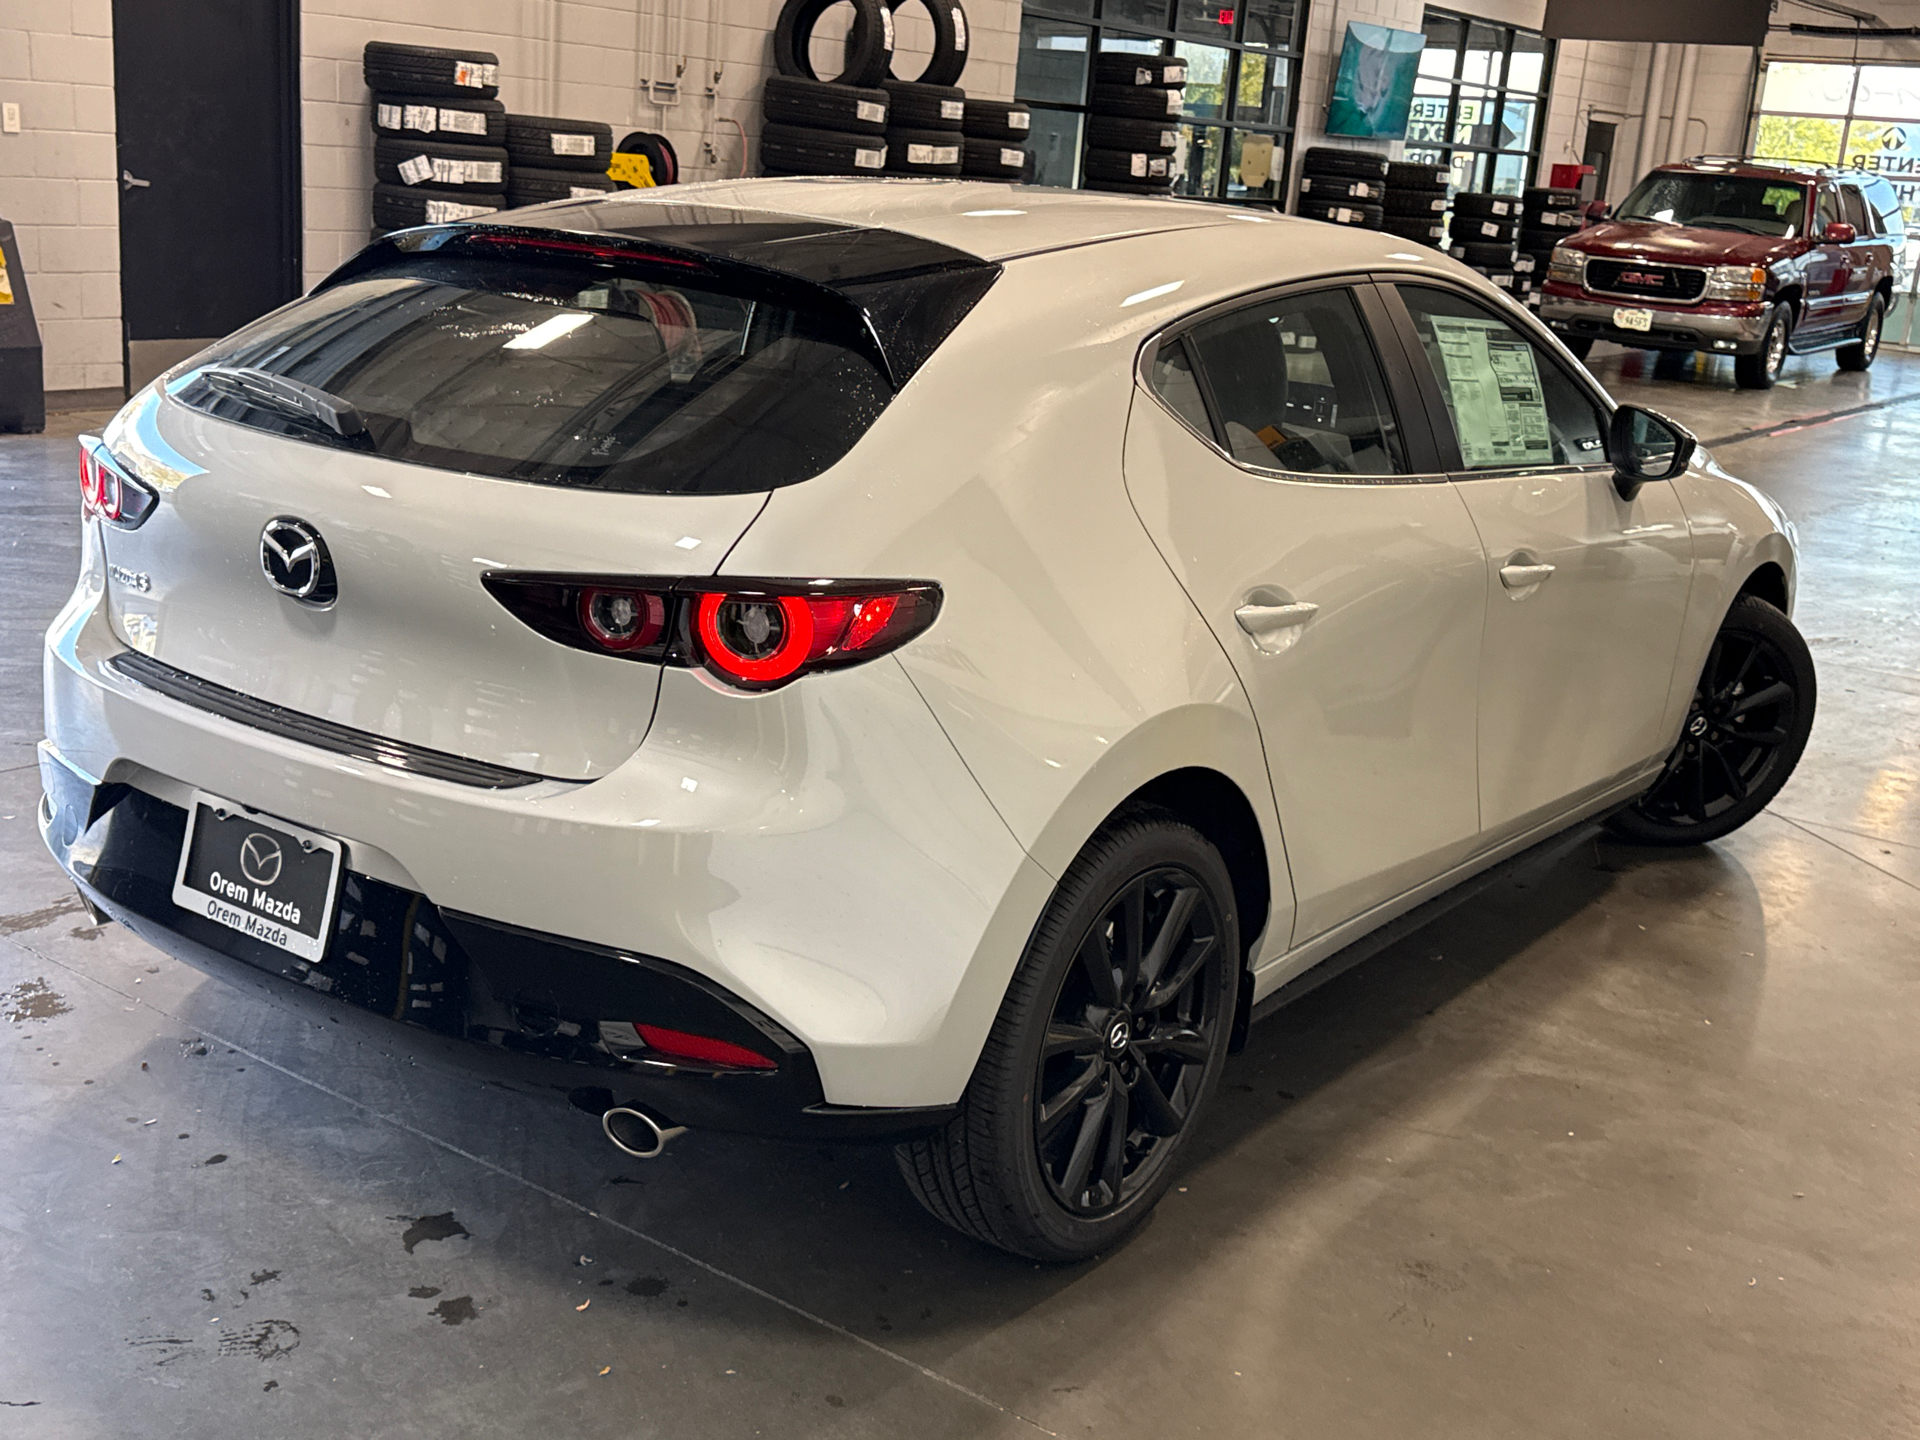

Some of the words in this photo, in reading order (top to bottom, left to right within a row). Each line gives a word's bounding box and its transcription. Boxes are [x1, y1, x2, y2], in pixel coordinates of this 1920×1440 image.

[1620, 271, 1665, 286] GMC
[210, 871, 248, 903] Orem
[252, 888, 301, 924] Mazda
[207, 900, 241, 927] Orem
[245, 915, 288, 946] Mazda
